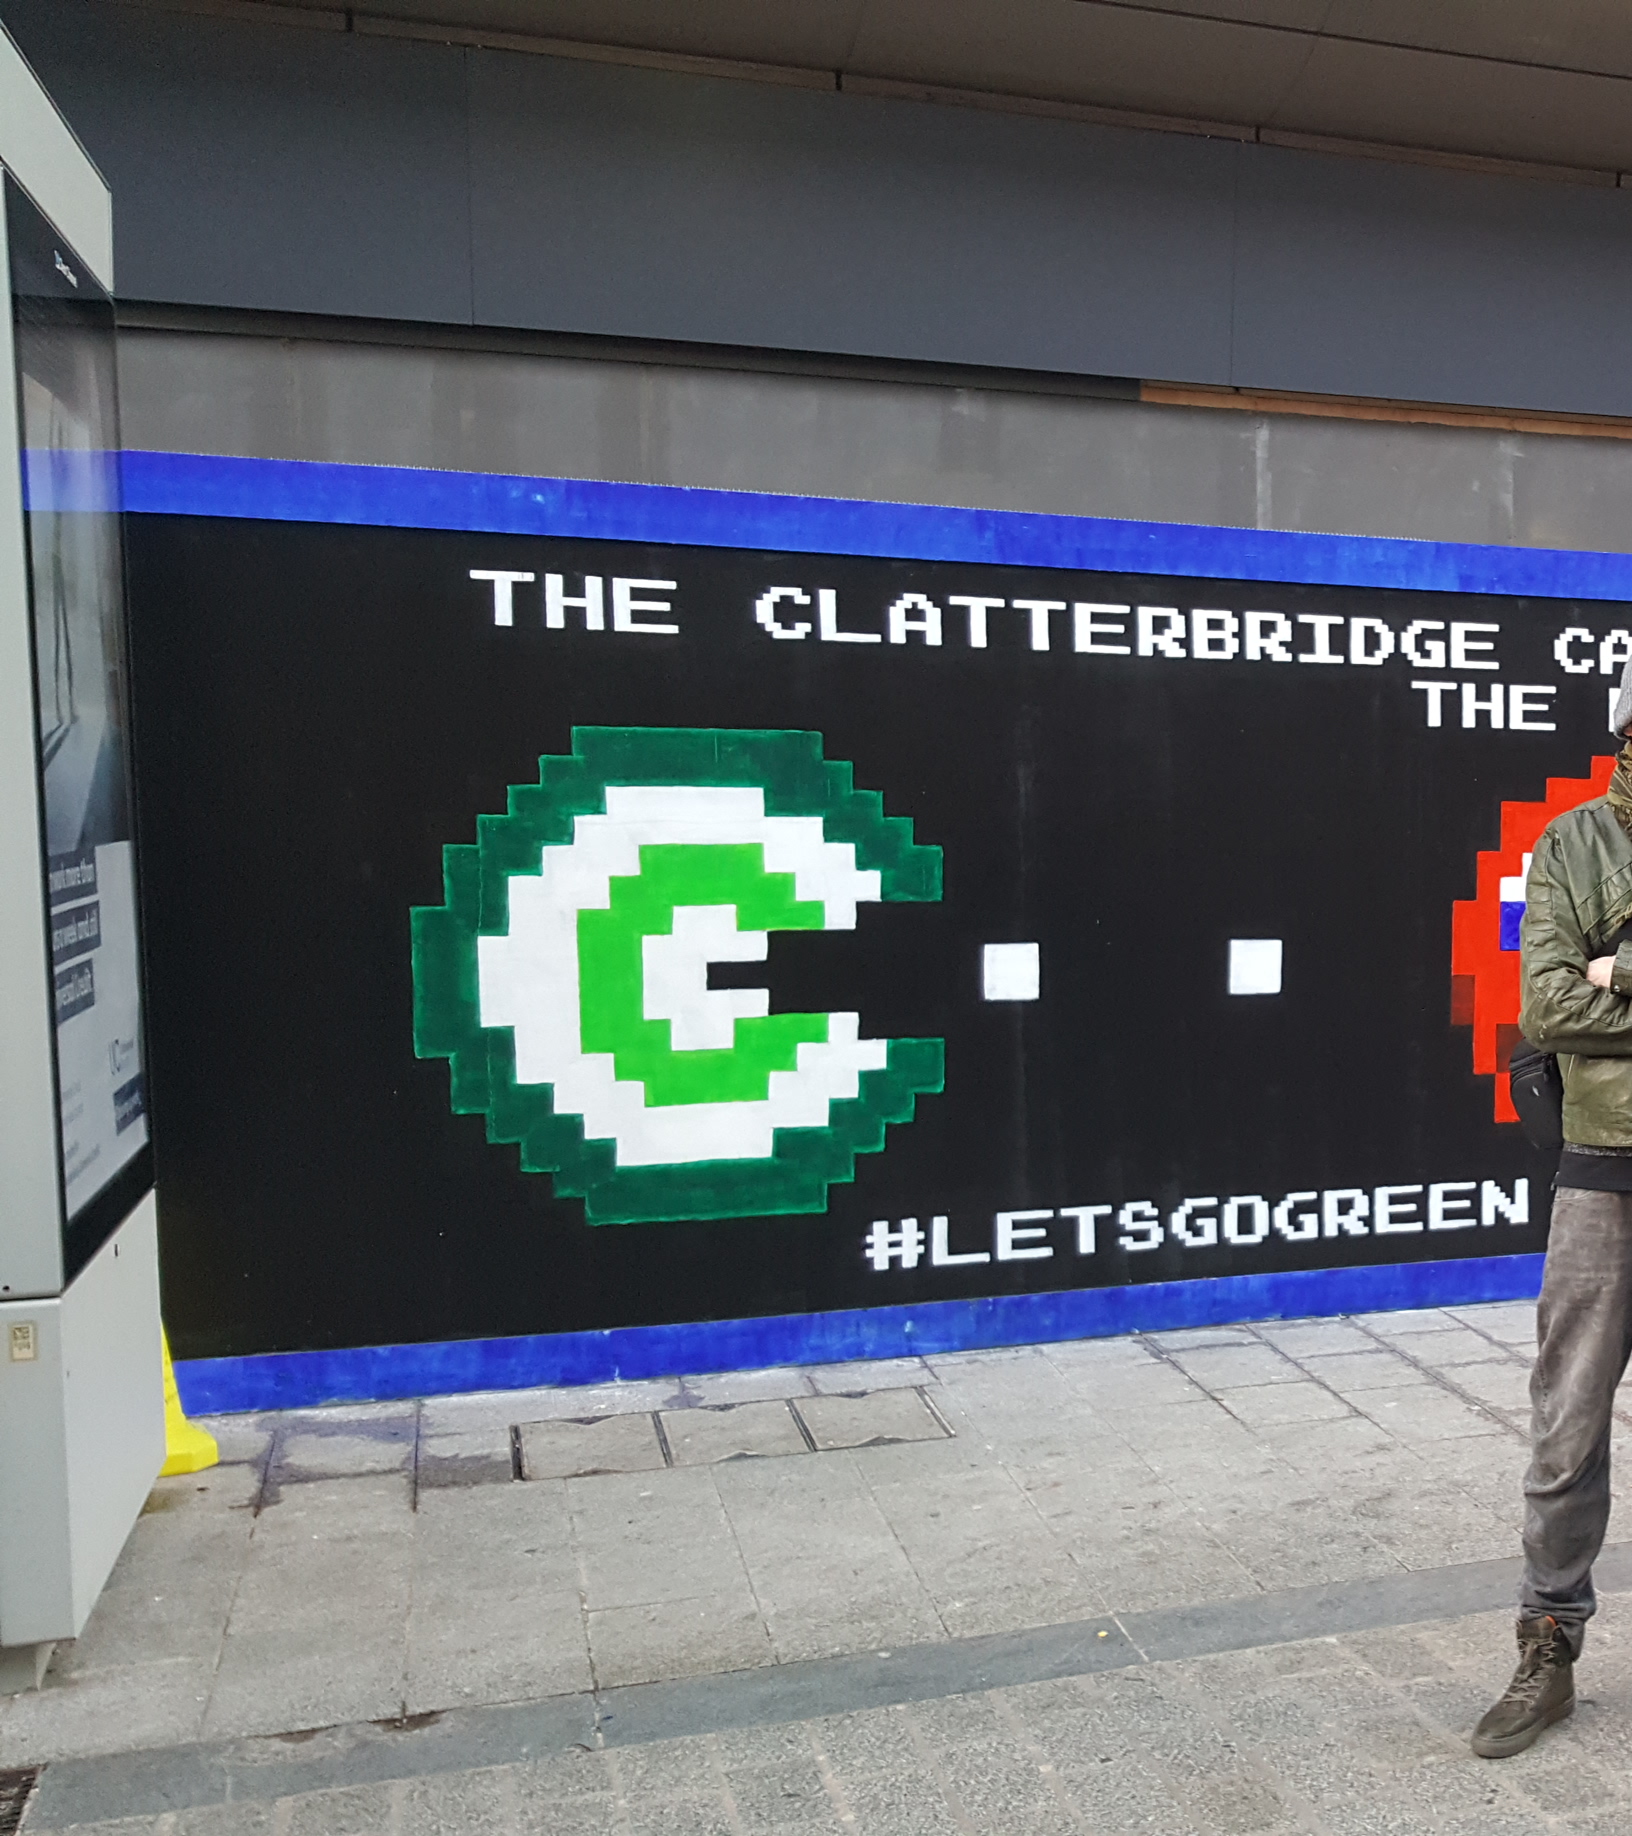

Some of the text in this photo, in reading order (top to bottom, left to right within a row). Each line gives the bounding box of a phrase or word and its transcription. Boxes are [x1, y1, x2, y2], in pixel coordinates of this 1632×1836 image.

[469, 569, 680, 634] THE
[755, 586, 1500, 670] CLATTERBRIDGE
[1411, 680, 1557, 731] THE
[865, 1177, 1529, 1271] #LETSGOGREEN
